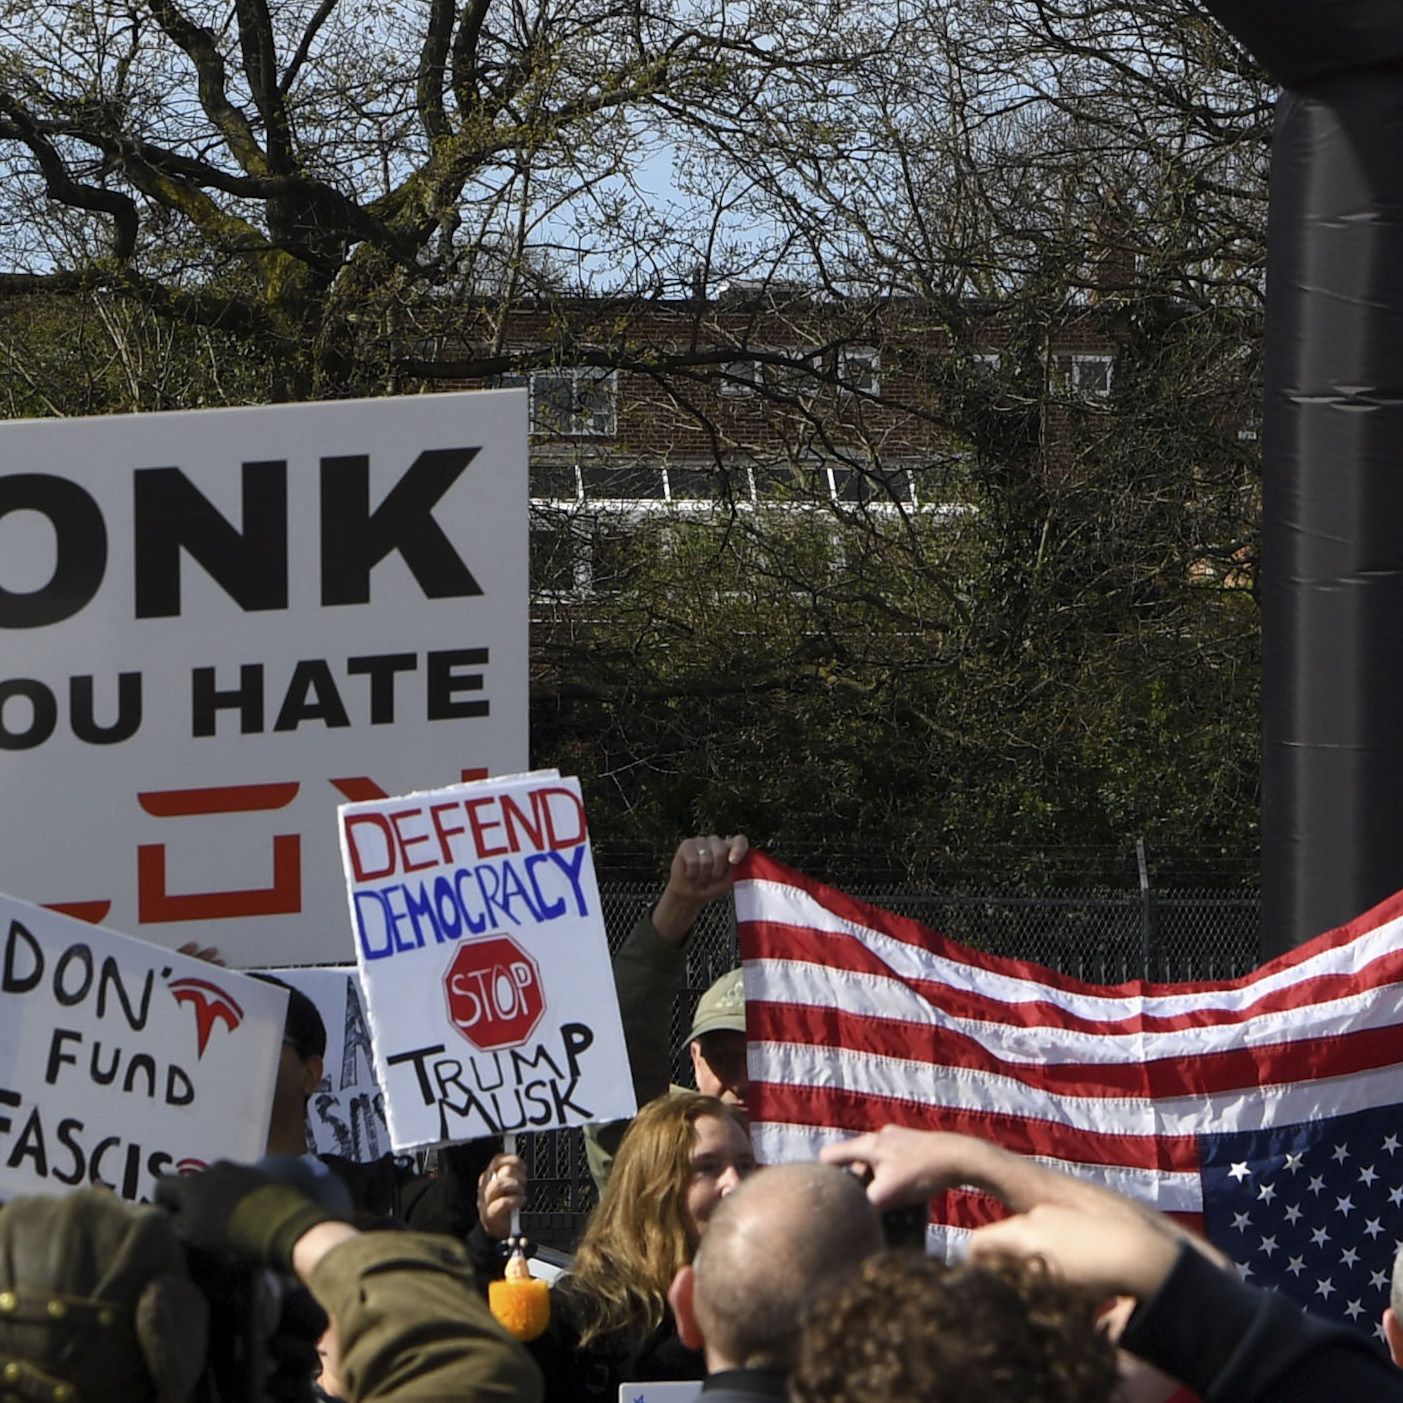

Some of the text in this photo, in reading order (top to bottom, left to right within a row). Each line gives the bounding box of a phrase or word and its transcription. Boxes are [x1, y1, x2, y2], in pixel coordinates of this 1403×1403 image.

[191, 647, 491, 738] HATE
[343, 787, 588, 883] DEFEND
[352, 845, 589, 961] DEMOCRACY
[451, 961, 532, 1028] STOP
[45, 1027, 195, 1107] FUND
[386, 1022, 594, 1106] TRUMP
[439, 1076, 595, 1139] MUSK
